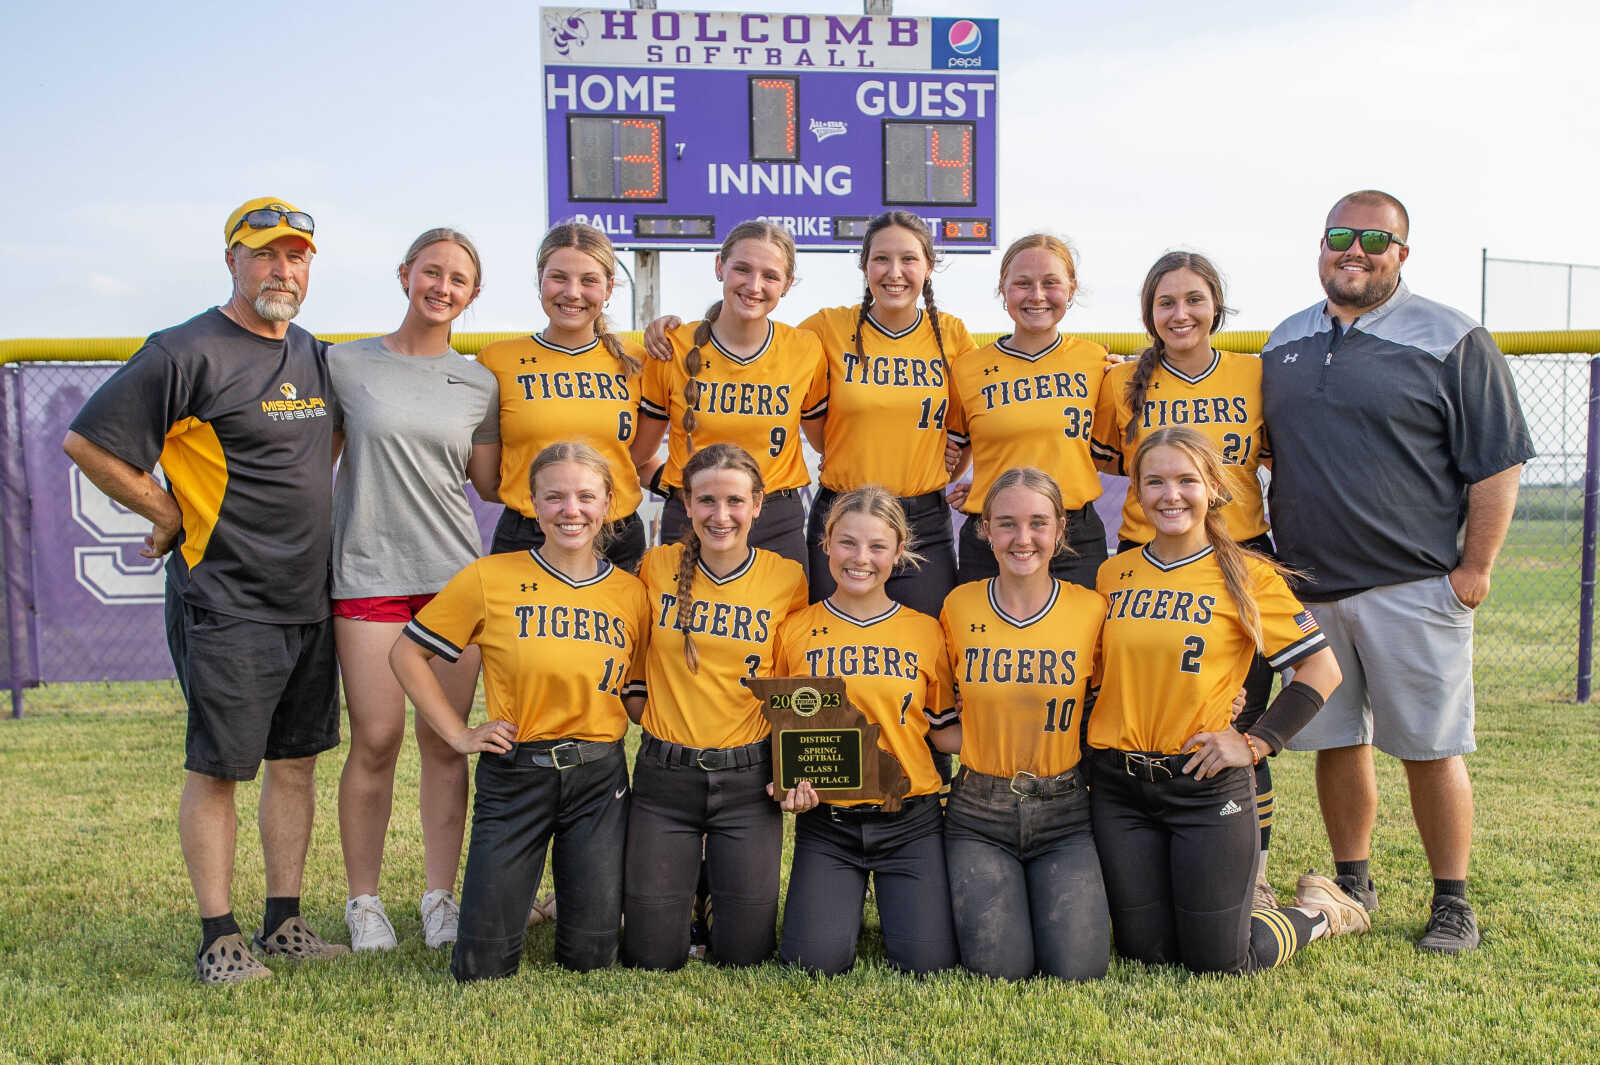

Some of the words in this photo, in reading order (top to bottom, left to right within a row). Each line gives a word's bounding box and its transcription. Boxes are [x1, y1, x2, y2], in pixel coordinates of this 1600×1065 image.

[601, 10, 919, 47] HOLCOMB
[647, 45, 875, 68] SOFTBALL
[948, 56, 982, 69] pepsi
[547, 74, 676, 112] HOME
[856, 80, 995, 118] GUEST
[758, 80, 794, 153] 7
[623, 119, 661, 198] 3
[931, 130, 970, 198] 4
[709, 163, 852, 195] INNING
[756, 216, 831, 236] TRIKE
[517, 371, 630, 401] TIGERS
[842, 351, 944, 388] TIGERS
[261, 397, 326, 412] MISSOURI
[693, 380, 791, 416] TIGERS
[981, 372, 1089, 410] TIGERS
[268, 407, 327, 421] TIGERS
[617, 410, 632, 442] 6
[917, 396, 948, 430] 14
[1063, 406, 1092, 440] 32
[1142, 396, 1248, 429] TIGERS
[768, 426, 787, 458] 9
[1221, 432, 1252, 466] 21
[1106, 588, 1215, 625] TIGERS
[515, 605, 625, 649] TIGERS
[806, 645, 919, 681] TIGERS
[965, 647, 1076, 686] TIGERS
[1180, 634, 1206, 674] 2
[597, 657, 625, 696] 11
[771, 695, 790, 709] 20
[822, 694, 841, 708] 23
[1044, 697, 1076, 733] 10
[804, 765, 832, 773] CLASS
[821, 776, 850, 784] PLACE
[1220, 805, 1242, 816] adidas
